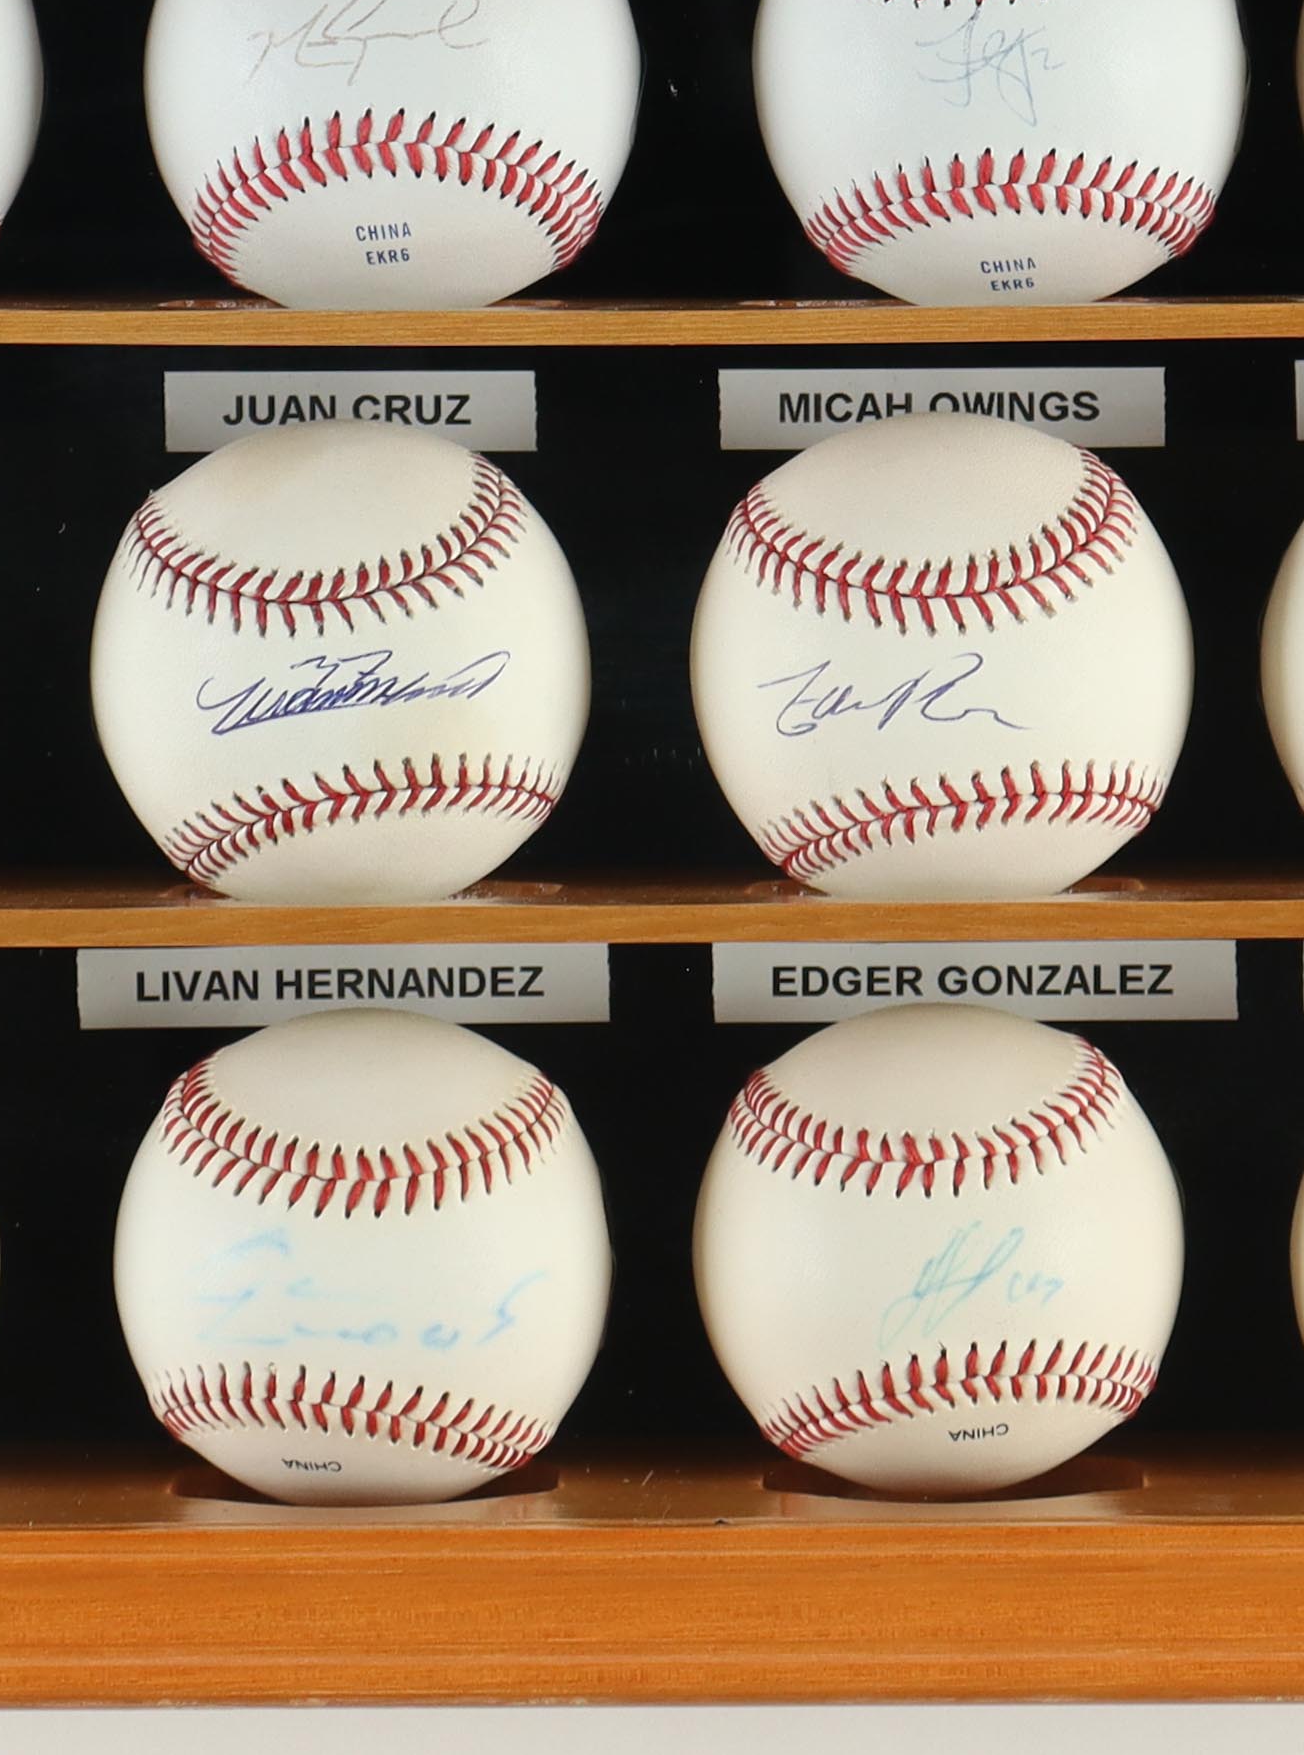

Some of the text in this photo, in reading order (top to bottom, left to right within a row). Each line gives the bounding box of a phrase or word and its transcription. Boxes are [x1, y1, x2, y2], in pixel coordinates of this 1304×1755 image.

[355, 221, 412, 242] CHINA
[365, 247, 410, 265] EKR6
[980, 256, 1037, 274] CHINA
[990, 277, 1035, 292] EKR6
[222, 394, 472, 426] JUAN CRUZ
[779, 391, 1100, 423] MICAH OWINGS
[136, 966, 545, 1002] LIVAN HERNANDEZ
[772, 964, 1174, 997] EDGER GONZALEZ
[948, 1423, 1010, 1442] CHINA
[281, 1458, 342, 1473] CHINA
